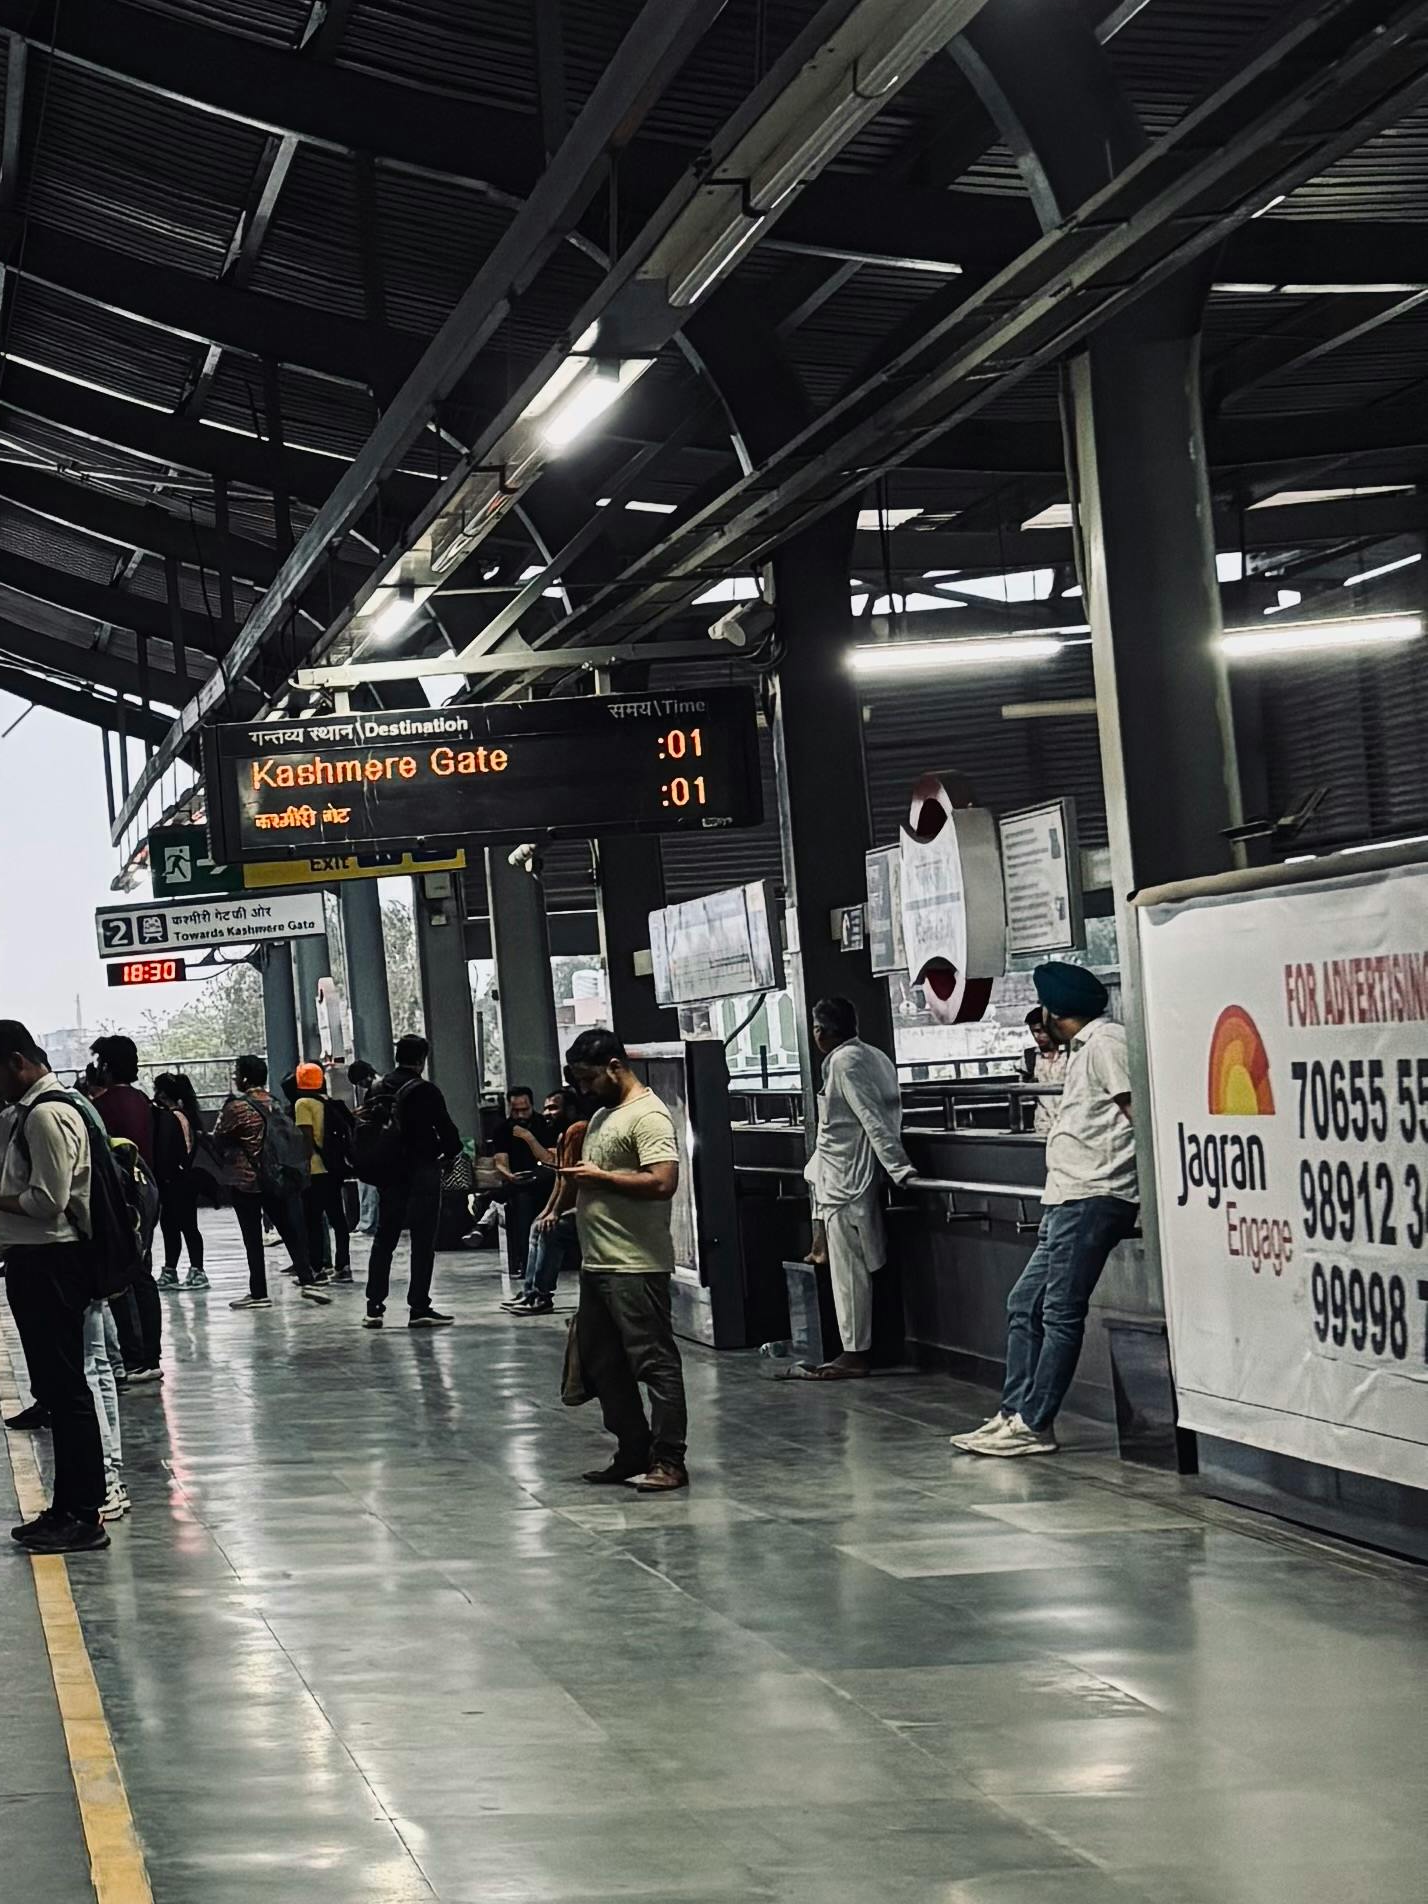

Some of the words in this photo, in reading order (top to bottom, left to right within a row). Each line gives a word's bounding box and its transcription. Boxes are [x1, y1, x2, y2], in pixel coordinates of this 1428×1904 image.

[251, 755, 417, 790] Kashmere
[430, 746, 509, 776] Gate
[109, 920, 129, 945] 2
[174, 928, 224, 942] Towards
[226, 924, 285, 937] Kashmere
[287, 920, 315, 931] Gate
[123, 961, 176, 983] 18:30
[1285, 962, 1320, 1028] FOR
[1323, 950, 1428, 1026] ADVERTISIN
[1291, 1059, 1388, 1143] 70655
[1177, 1122, 1267, 1209] Jagran
[1300, 1158, 1398, 1246] 98912
[1226, 1201, 1293, 1277] Engage
[1312, 1261, 1407, 1361] 99998
